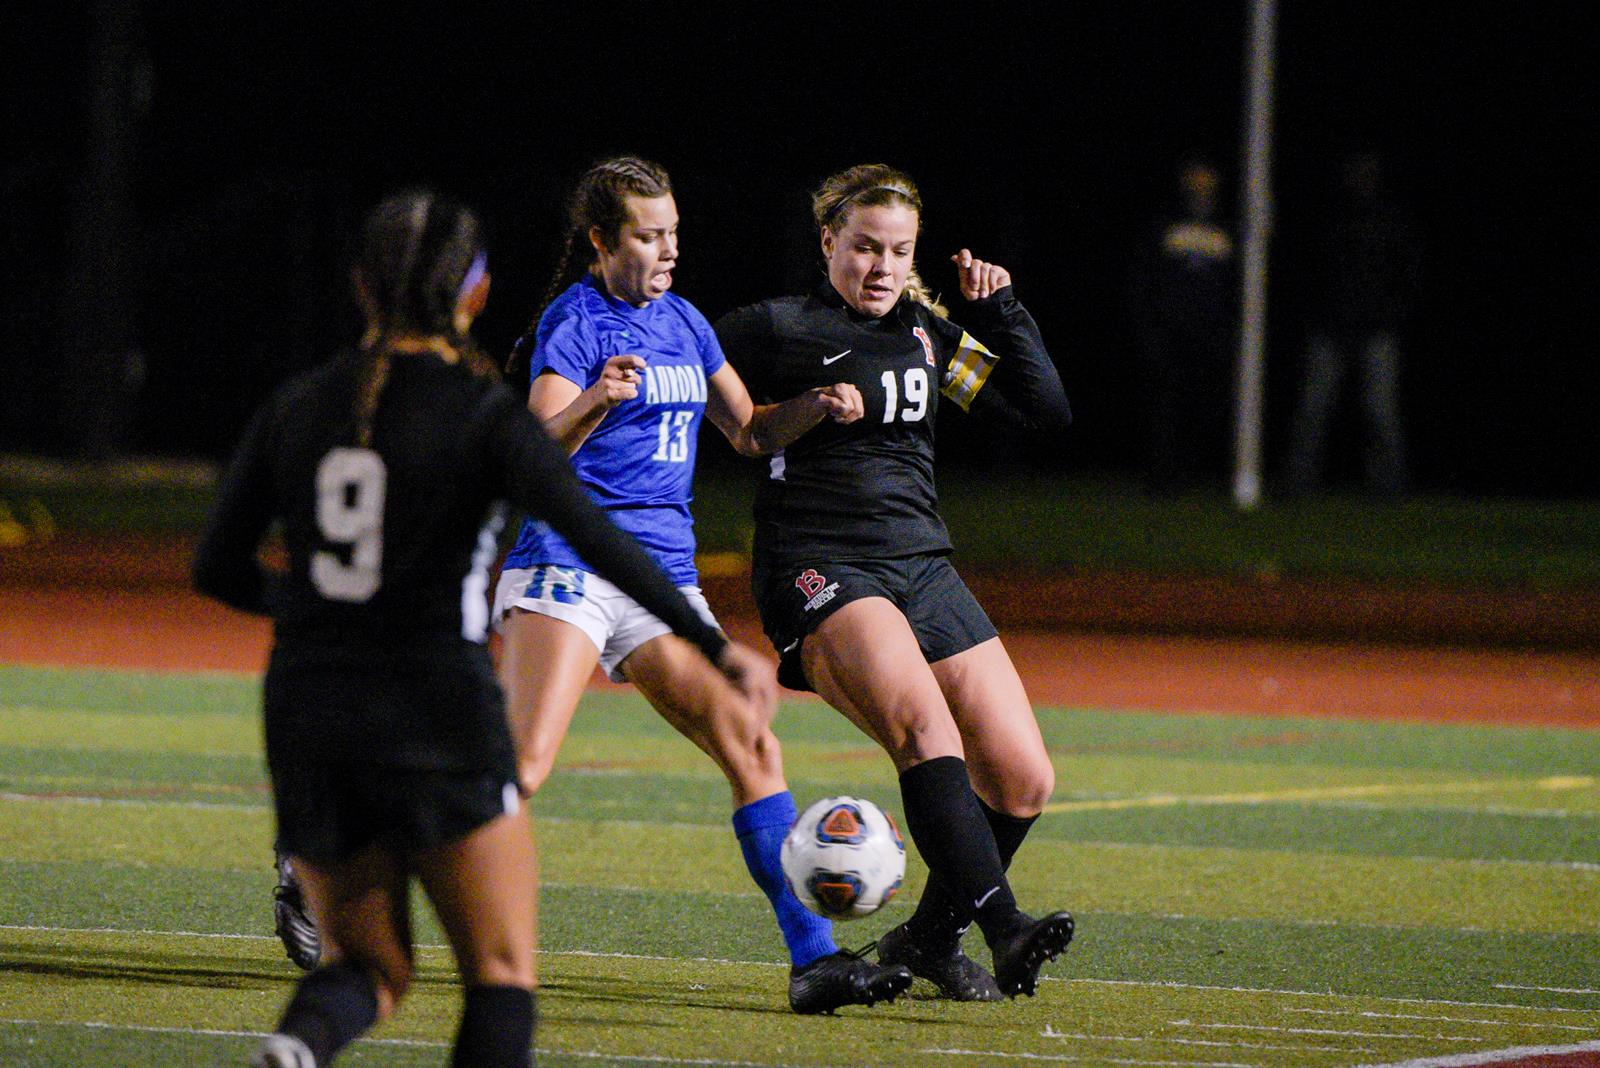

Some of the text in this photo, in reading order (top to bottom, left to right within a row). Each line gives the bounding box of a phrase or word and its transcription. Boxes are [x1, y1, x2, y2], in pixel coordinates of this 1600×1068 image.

[881, 368, 928, 423] 19
[652, 411, 694, 462] 13
[310, 447, 387, 603] 9
[795, 568, 826, 600] B
